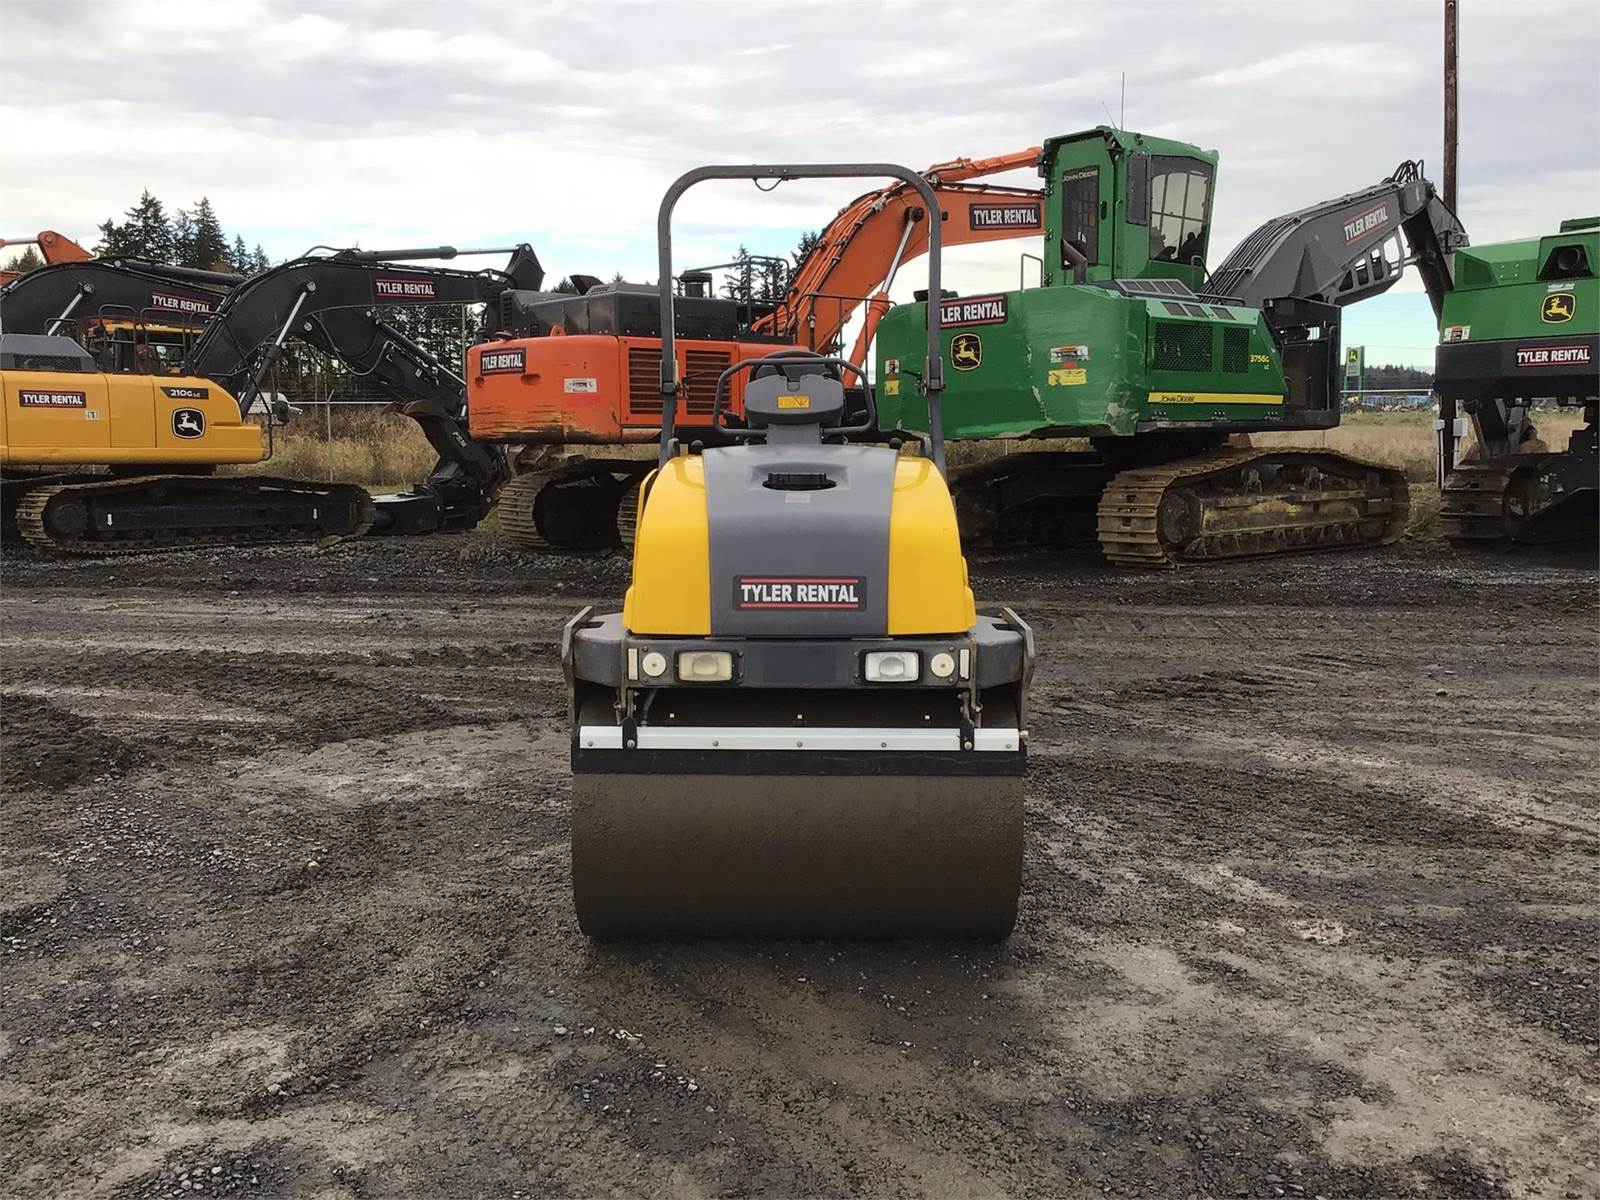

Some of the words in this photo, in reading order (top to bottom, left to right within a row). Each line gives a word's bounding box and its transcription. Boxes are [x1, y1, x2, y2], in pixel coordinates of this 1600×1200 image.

[973, 209, 1003, 225] TYLER
[1004, 208, 1038, 224] RENTAL
[1344, 217, 1366, 241] TYLER
[1364, 206, 1388, 231] RENTAL
[376, 282, 403, 294] TYLER
[404, 283, 435, 295] RENTAL
[151, 295, 179, 309] TYLER
[180, 300, 210, 313] RENTAL
[940, 305, 961, 324] LER
[963, 301, 1006, 321] RENTAL
[482, 355, 498, 370] TYLER
[498, 354, 523, 369] RENTAL
[1516, 350, 1549, 363] TYLER
[1550, 348, 1591, 362] RENTAL
[23, 394, 50, 404] TYLER
[51, 395, 83, 405] RENTAL
[170, 389, 193, 397] 210G
[741, 583, 793, 602] TYLER
[796, 584, 859, 603] RENTAL
